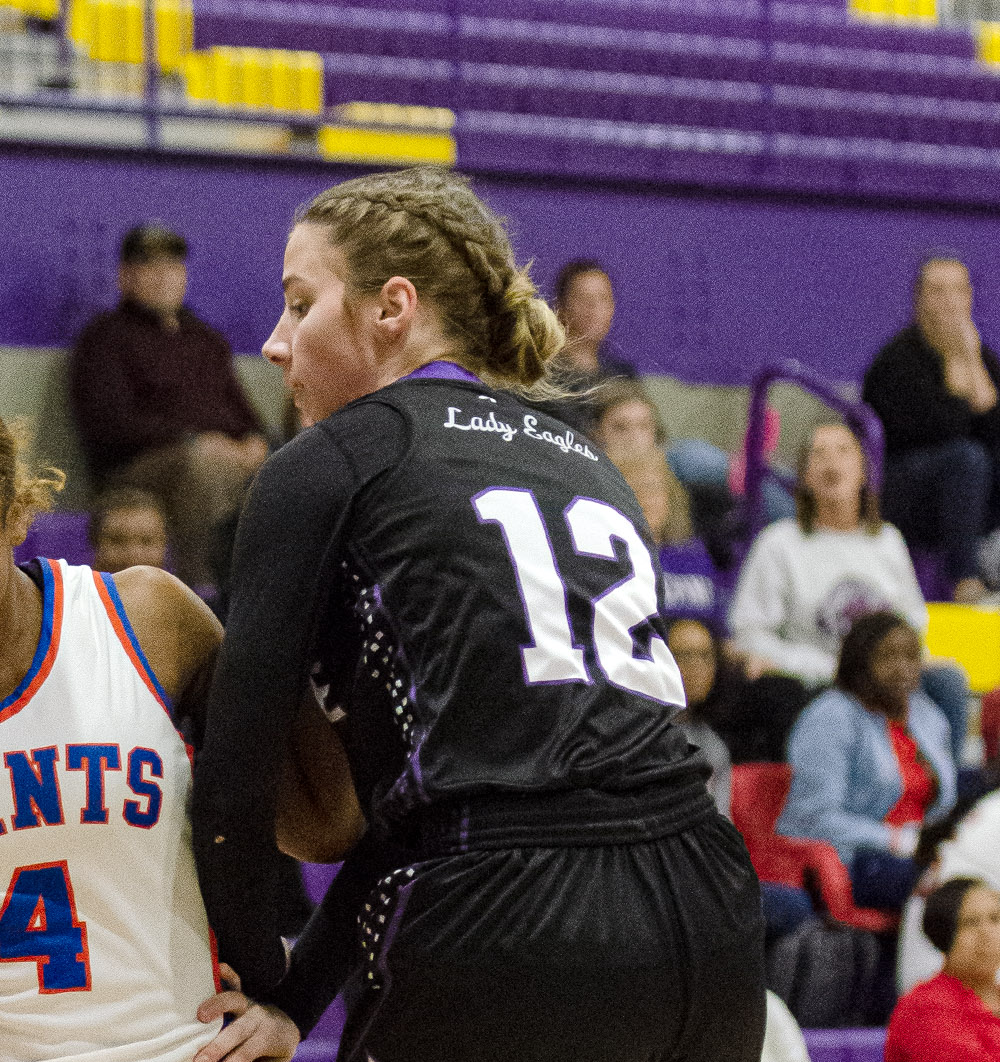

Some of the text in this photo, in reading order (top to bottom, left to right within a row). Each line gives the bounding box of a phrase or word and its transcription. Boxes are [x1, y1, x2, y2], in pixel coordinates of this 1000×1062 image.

[443, 406, 599, 462] Lady Eagles
[469, 485, 688, 710] 12
